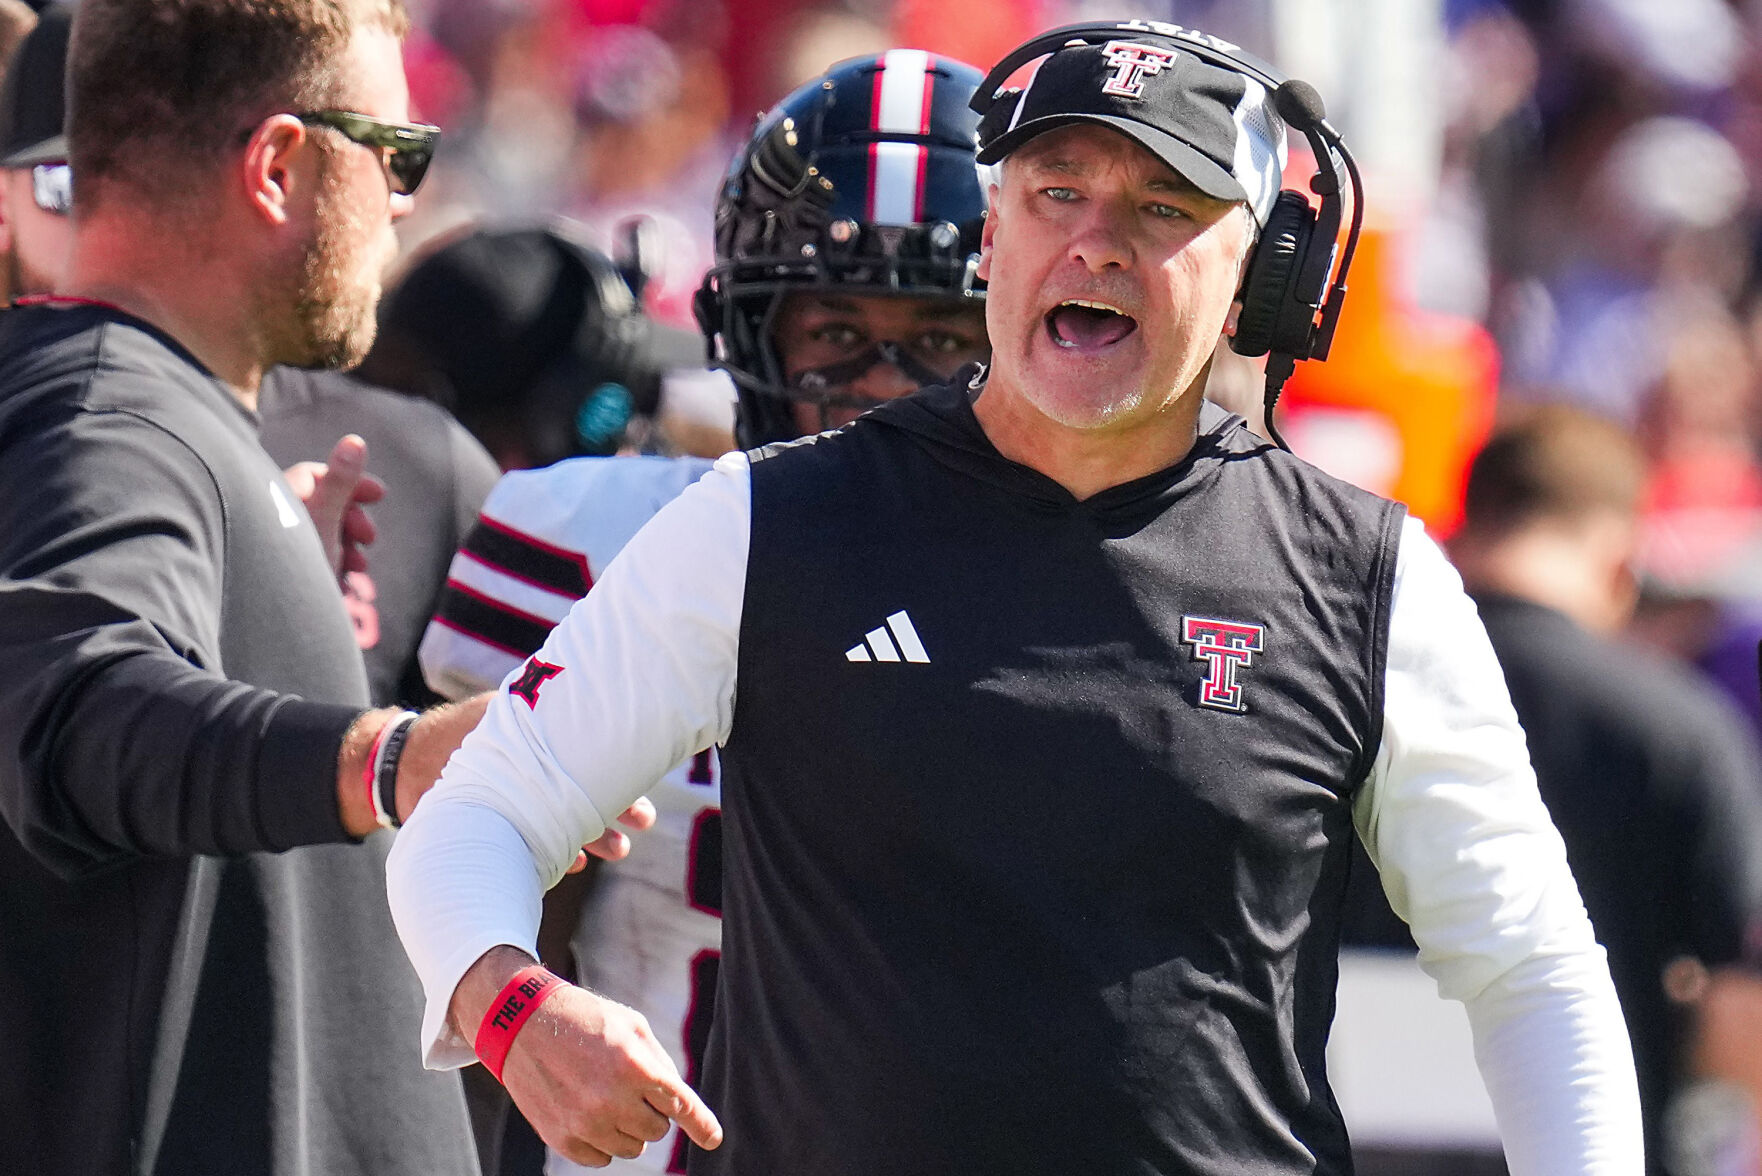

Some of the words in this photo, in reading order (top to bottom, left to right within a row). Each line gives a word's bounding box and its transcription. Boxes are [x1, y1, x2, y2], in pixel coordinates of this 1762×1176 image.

[1116, 19, 1241, 52] AT&T
[491, 995, 526, 1031] THE
[518, 972, 553, 999] BRA
